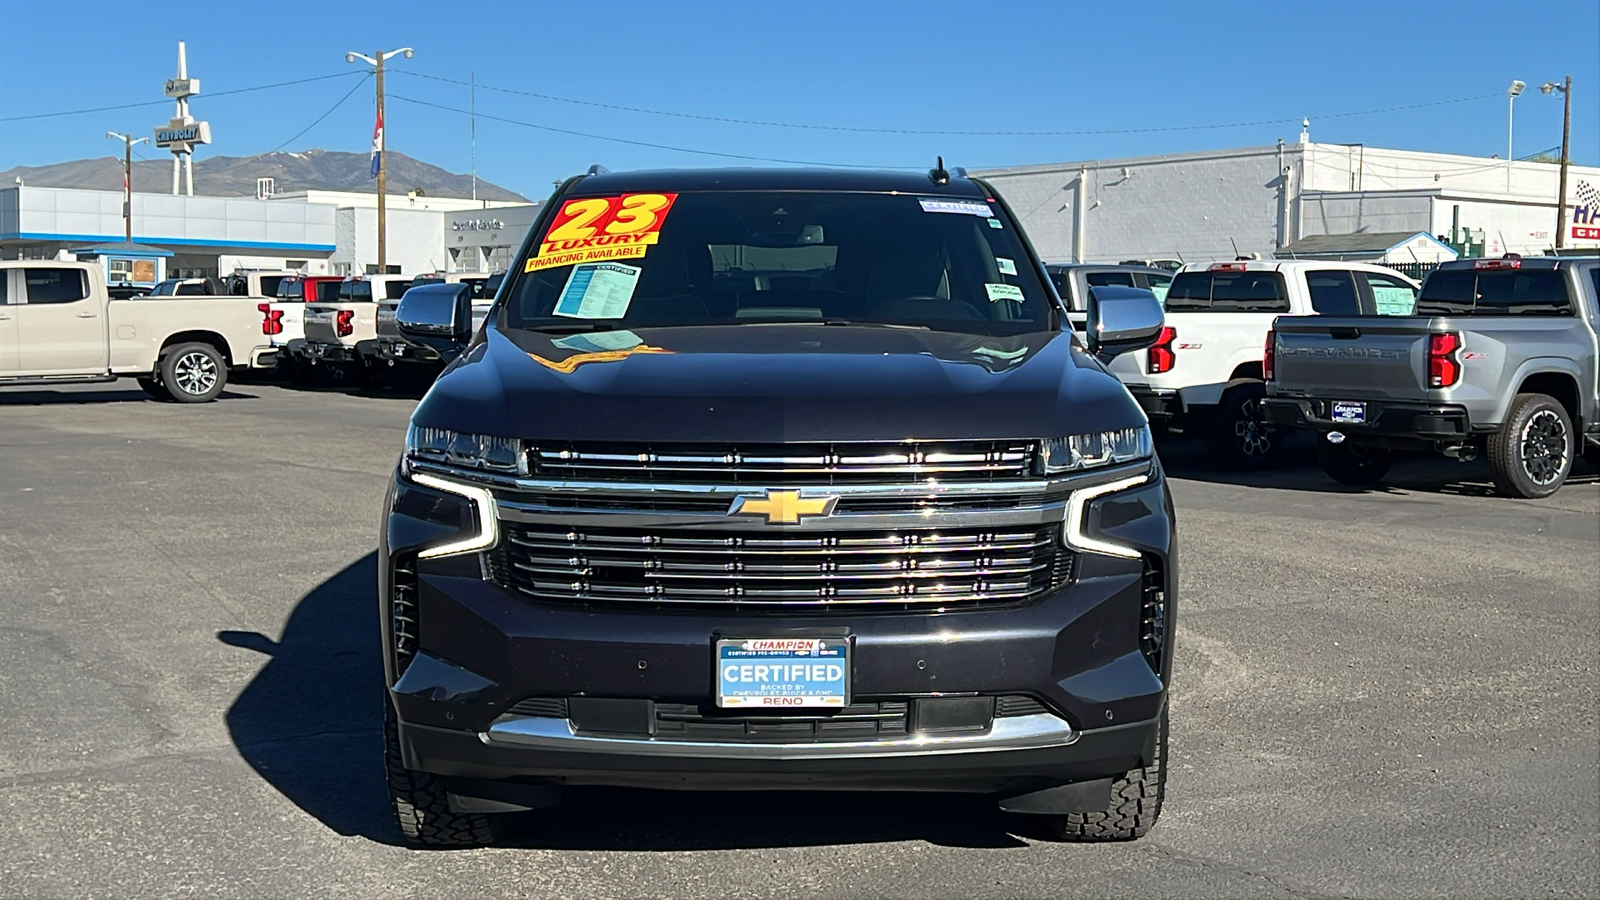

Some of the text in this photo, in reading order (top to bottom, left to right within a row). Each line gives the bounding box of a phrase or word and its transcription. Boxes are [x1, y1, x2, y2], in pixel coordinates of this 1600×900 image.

[157, 128, 198, 142] CHEVROLET
[924, 202, 988, 212] CERTIFIED
[548, 193, 670, 241] 23
[1535, 231, 1548, 239] EXIT
[546, 233, 649, 253] LUXURY
[529, 246, 643, 269] FINANCING AVAILABLE
[596, 265, 634, 275] CERTIFIED
[752, 641, 814, 650] CHAMPION
[723, 664, 843, 683] CERTIFIED
[763, 697, 803, 706] RENO
